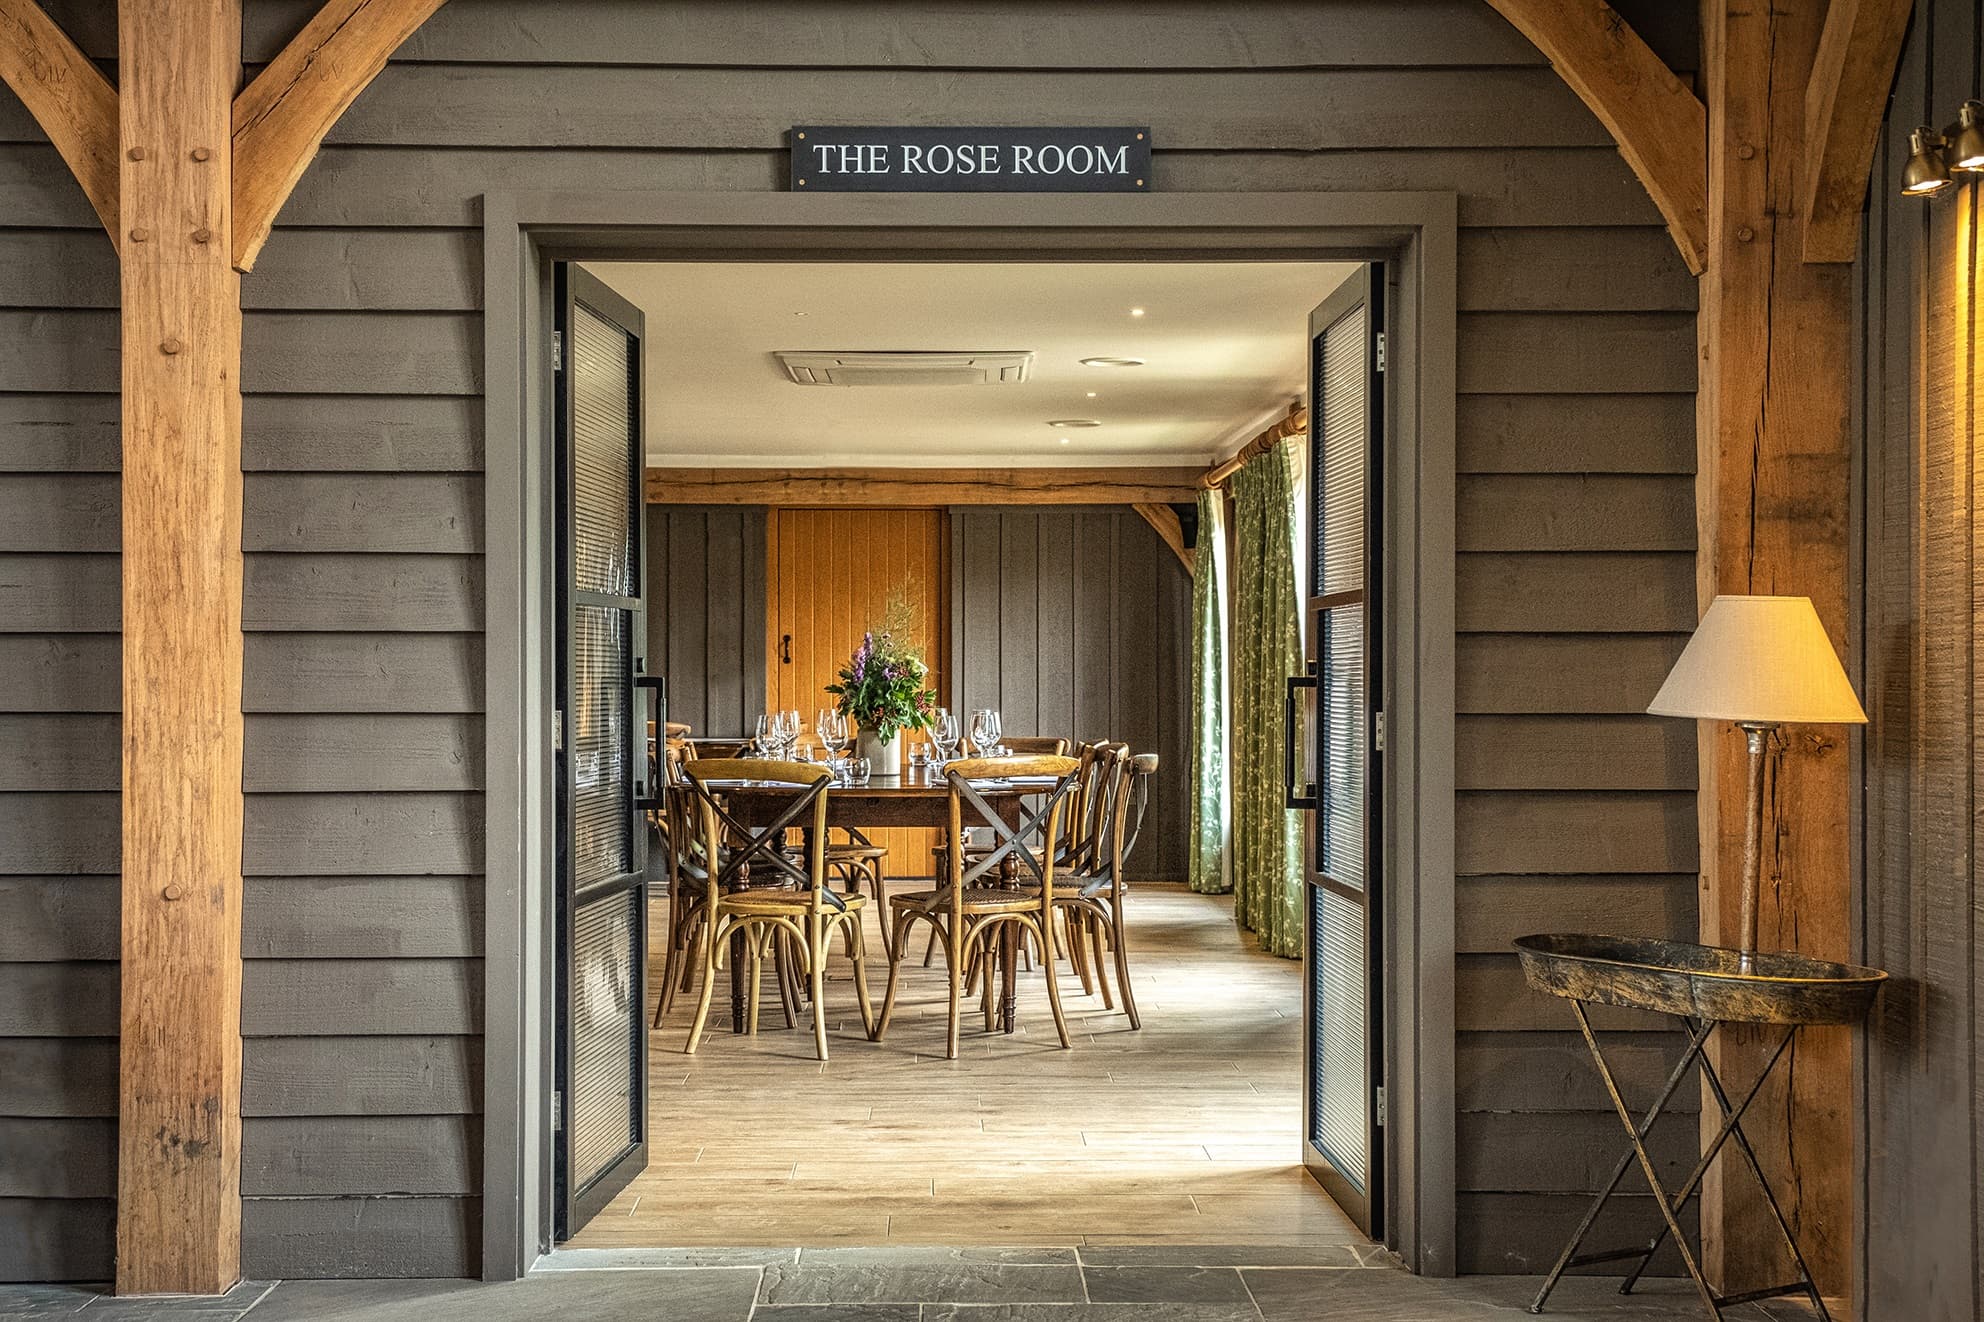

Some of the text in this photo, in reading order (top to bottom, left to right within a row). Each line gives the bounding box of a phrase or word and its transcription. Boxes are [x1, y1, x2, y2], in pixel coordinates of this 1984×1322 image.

[812, 144, 1129, 175] THE ROSE ROOM
